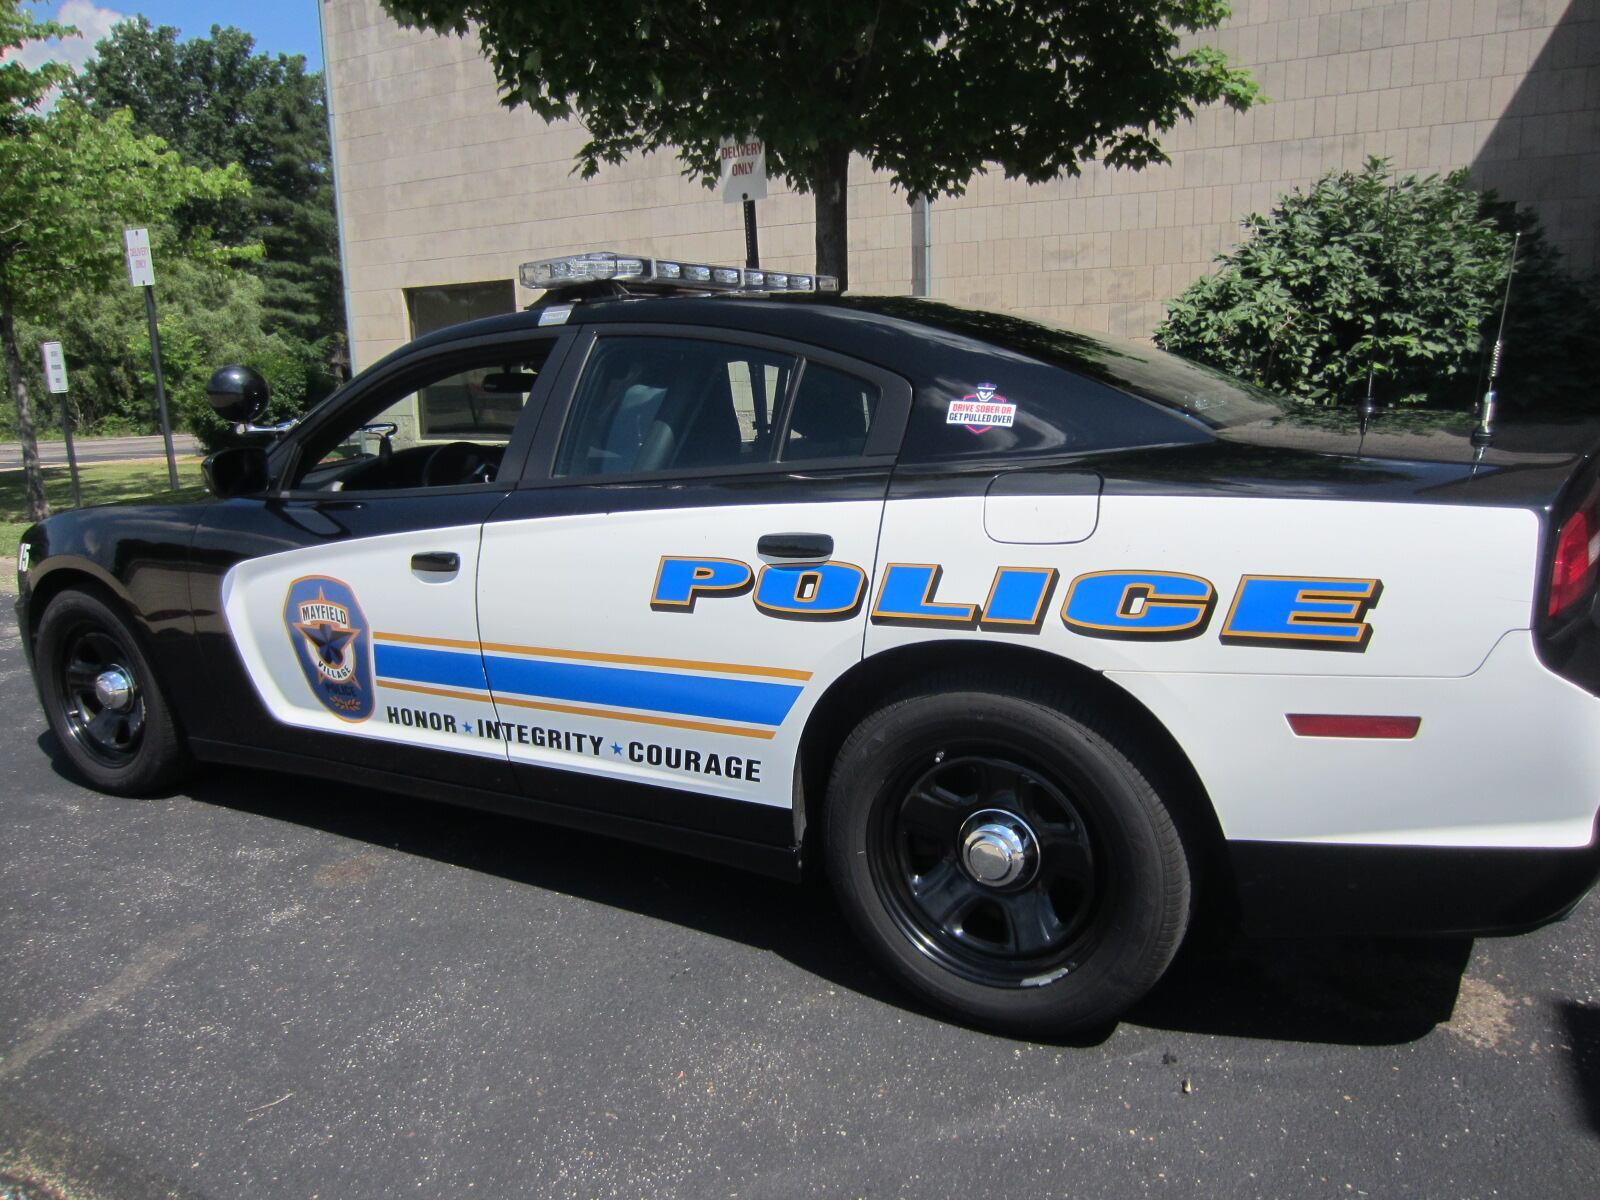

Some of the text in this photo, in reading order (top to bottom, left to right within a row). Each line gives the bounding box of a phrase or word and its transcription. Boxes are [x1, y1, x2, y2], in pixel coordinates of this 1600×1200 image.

[721, 143, 763, 160] DELIVERY
[732, 162, 754, 176] ONLY
[949, 412, 1012, 424] GET PULLED OVER
[952, 403, 1012, 415] DRIVE SOBER OR
[650, 555, 1384, 653] POLICE
[302, 605, 347, 625] MAYFIELD
[318, 660, 352, 680] VILLAGE
[386, 706, 762, 783] HONOR INTEGRITY COURAGE
